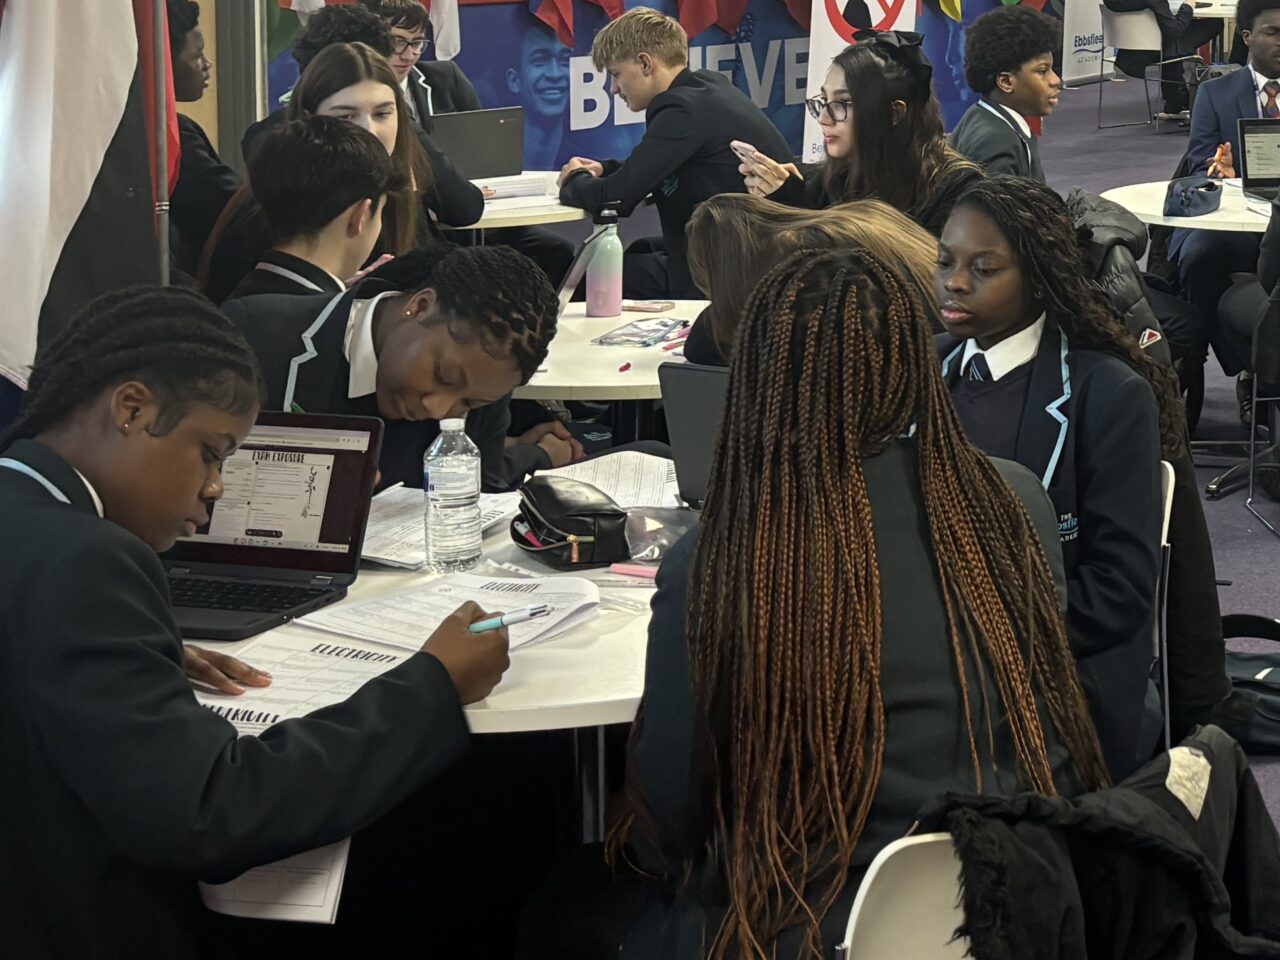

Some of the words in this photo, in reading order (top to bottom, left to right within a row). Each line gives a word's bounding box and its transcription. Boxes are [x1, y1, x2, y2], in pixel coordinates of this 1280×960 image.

[1074, 32, 1104, 47] Ebbsflee
[252, 450, 270, 461] EXAM
[272, 452, 305, 463] EXPOSURE
[310, 643, 400, 663] ELECTRICITY
